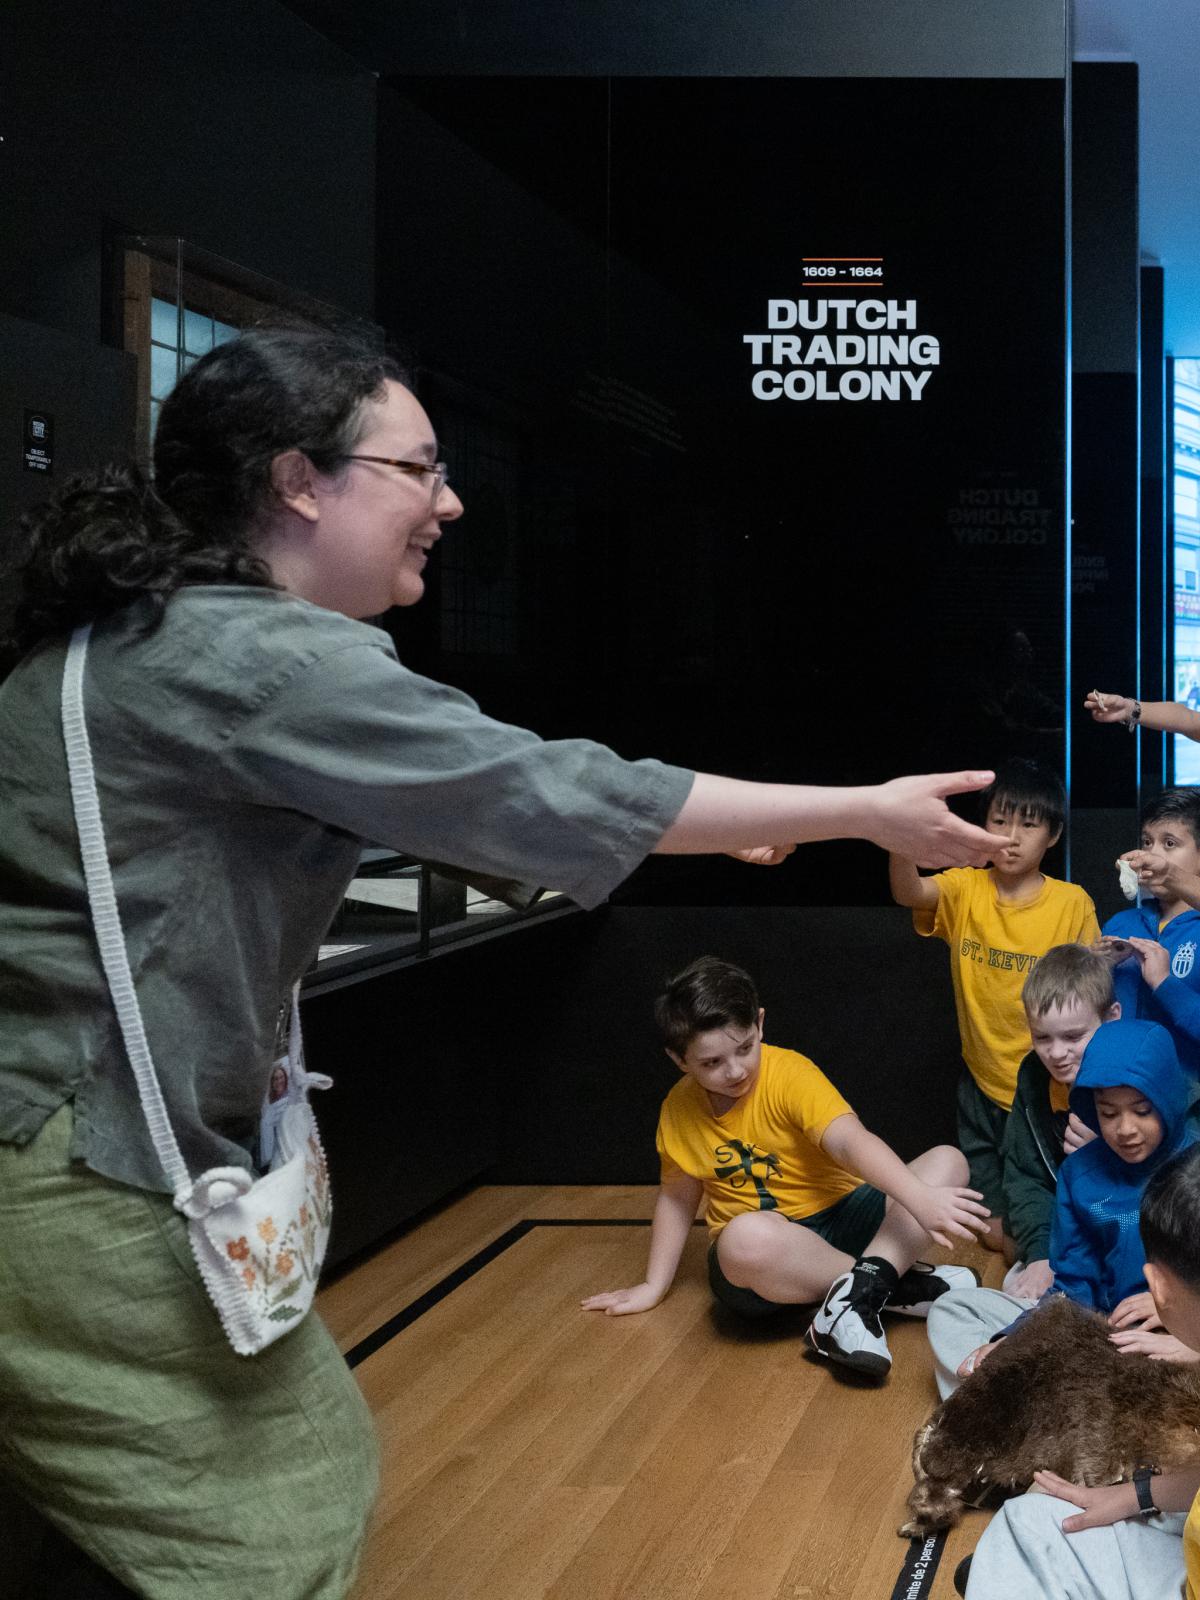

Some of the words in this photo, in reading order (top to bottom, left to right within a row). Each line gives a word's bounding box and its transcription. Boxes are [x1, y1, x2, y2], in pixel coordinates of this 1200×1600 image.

[803, 267, 836, 277] 1609
[849, 267, 883, 277] 1664
[768, 299, 917, 330] DUTCH
[743, 334, 940, 366] TRADING
[751, 370, 933, 401] COLONY
[961, 938, 983, 963] ST.
[988, 947, 1041, 973] KEVI
[920, 1534, 937, 1561] perso
[911, 1568, 926, 1580] de
[903, 1580, 922, 1600] mite
